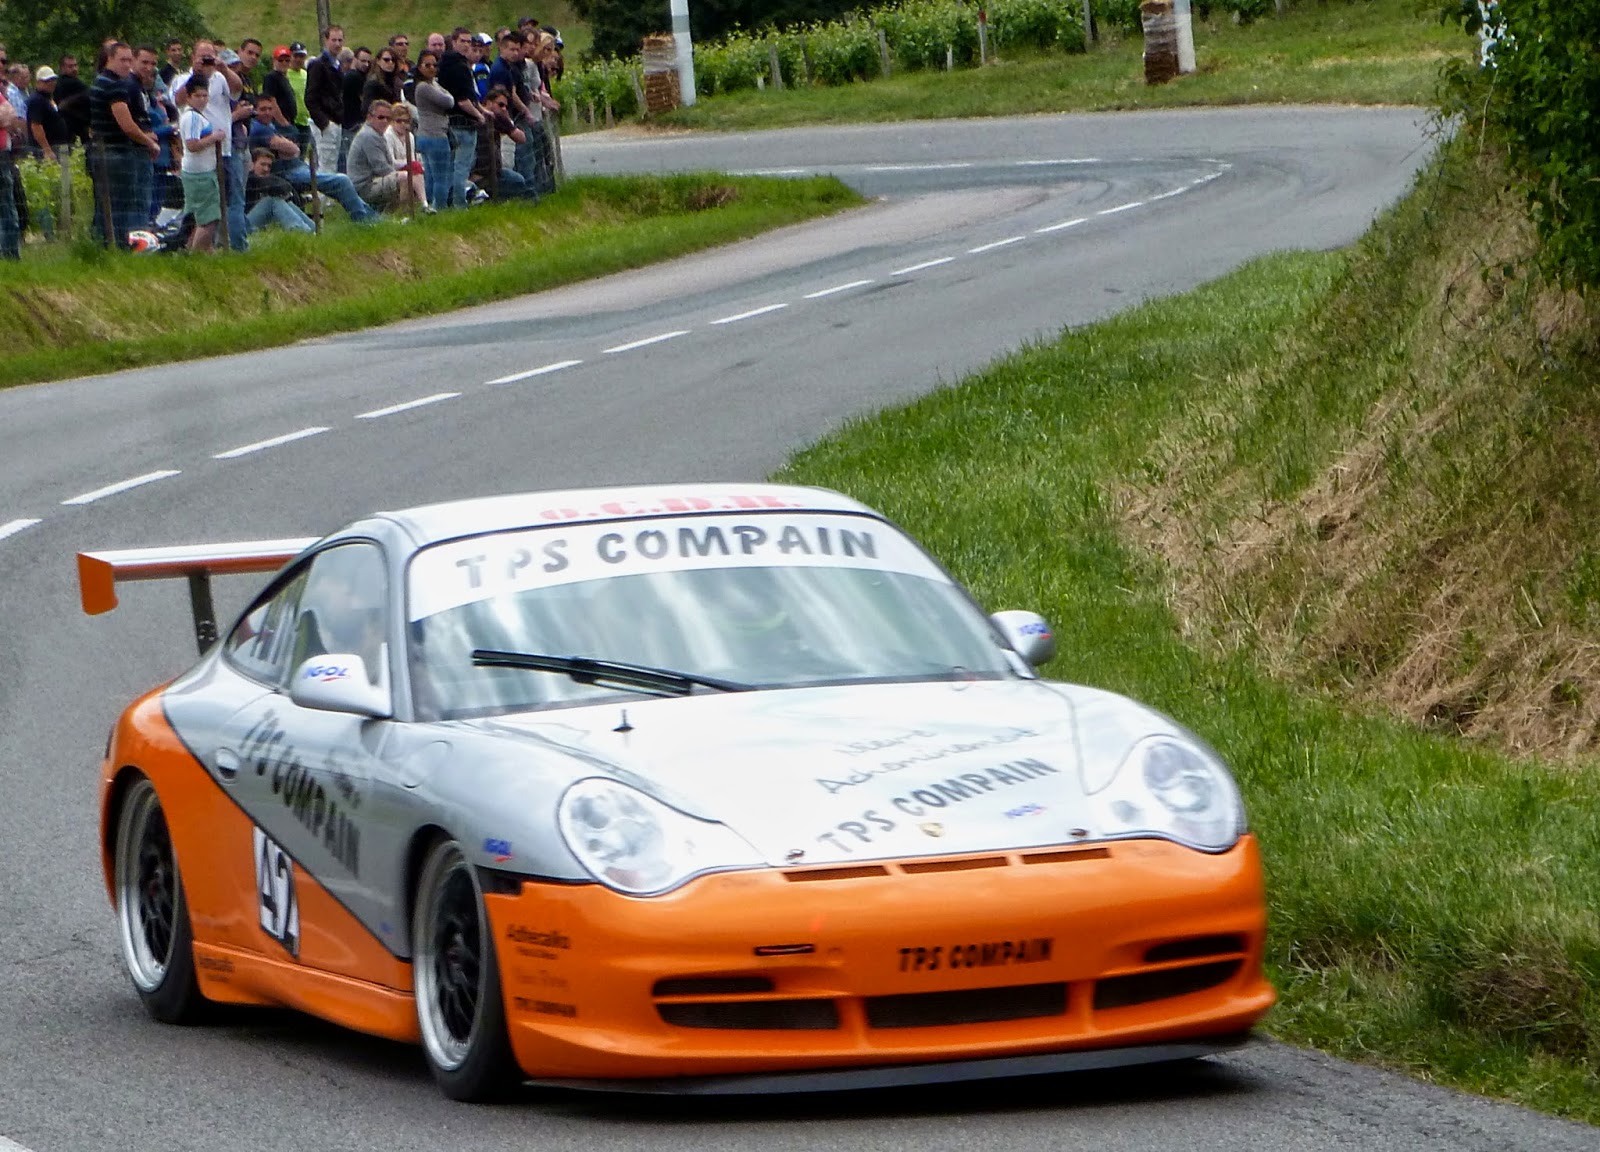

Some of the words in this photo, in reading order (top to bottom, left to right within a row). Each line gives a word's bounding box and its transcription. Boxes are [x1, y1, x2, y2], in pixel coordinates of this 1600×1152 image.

[455, 538, 569, 590] TPS
[595, 524, 879, 565] COMPAIN
[815, 808, 897, 853] TPS
[891, 756, 1061, 817] COMPAIN
[899, 946, 943, 972] TPS
